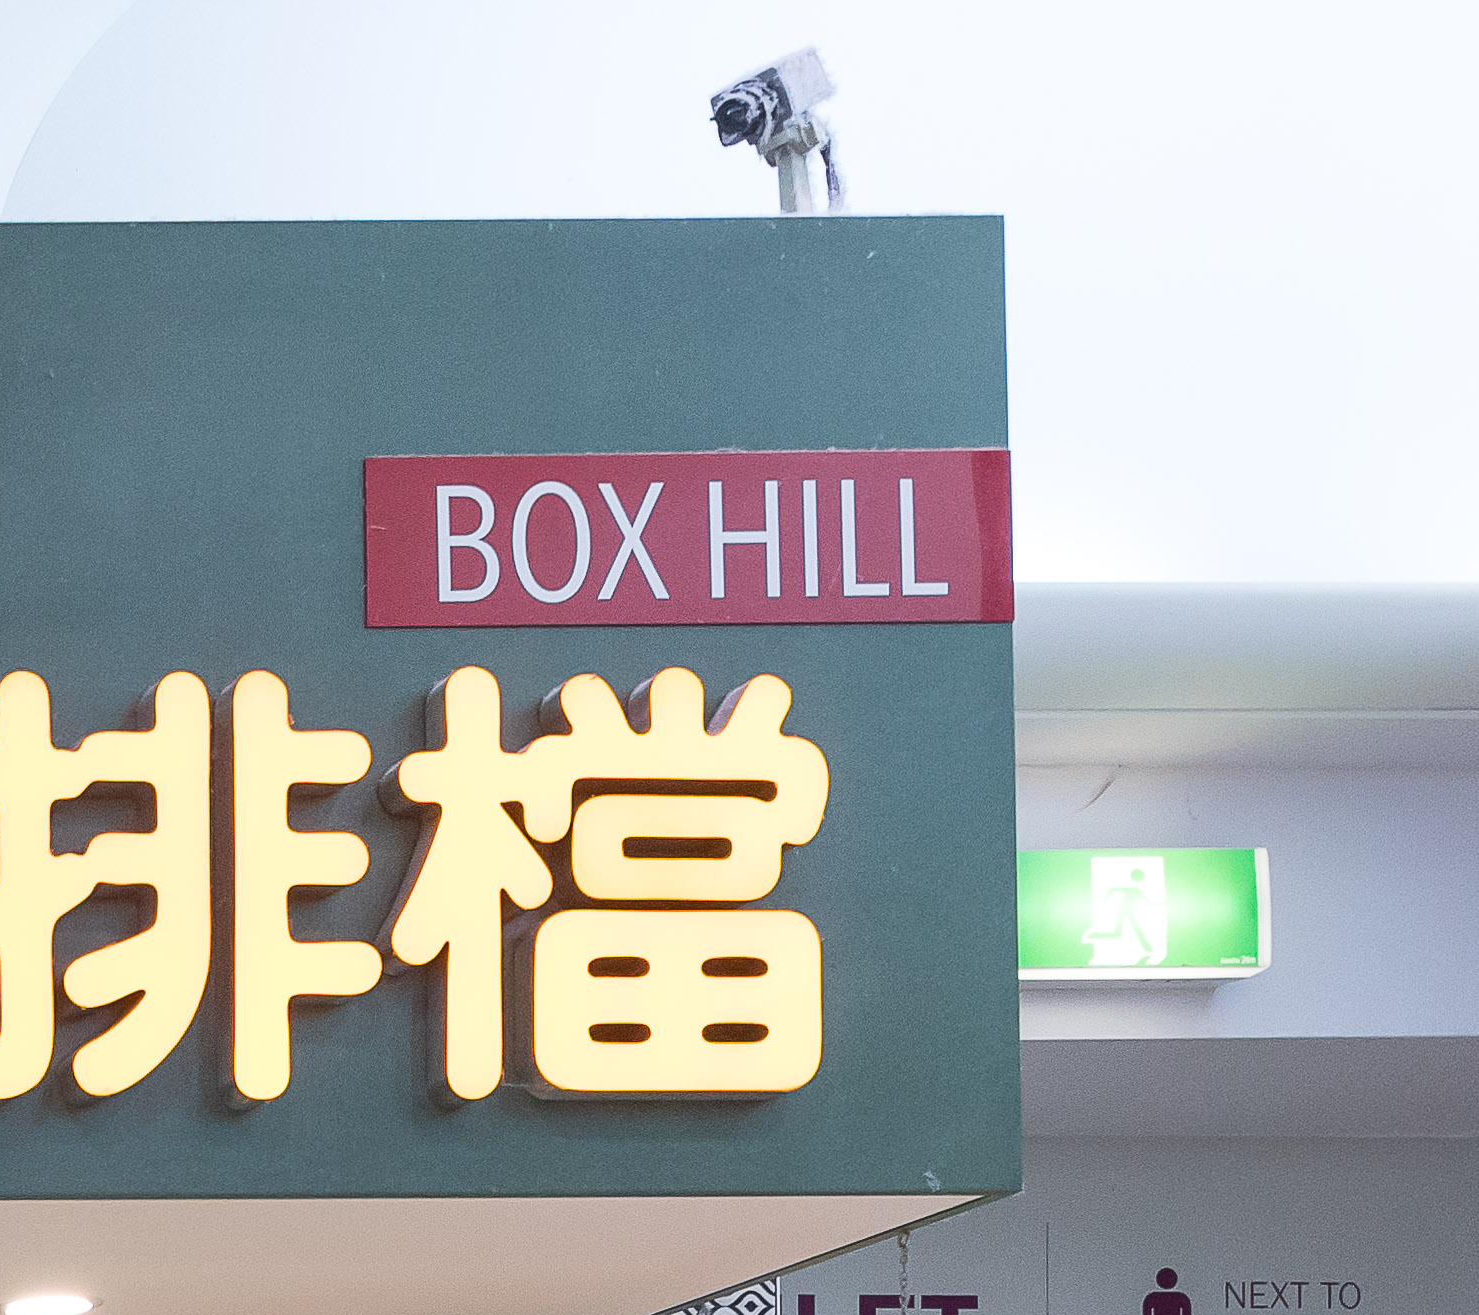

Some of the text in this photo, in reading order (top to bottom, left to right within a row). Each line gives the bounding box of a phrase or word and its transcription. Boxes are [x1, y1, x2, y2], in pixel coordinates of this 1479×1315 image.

[437, 479, 948, 603] BOX HILL
[1225, 1281, 1361, 1309] NEXT TO
